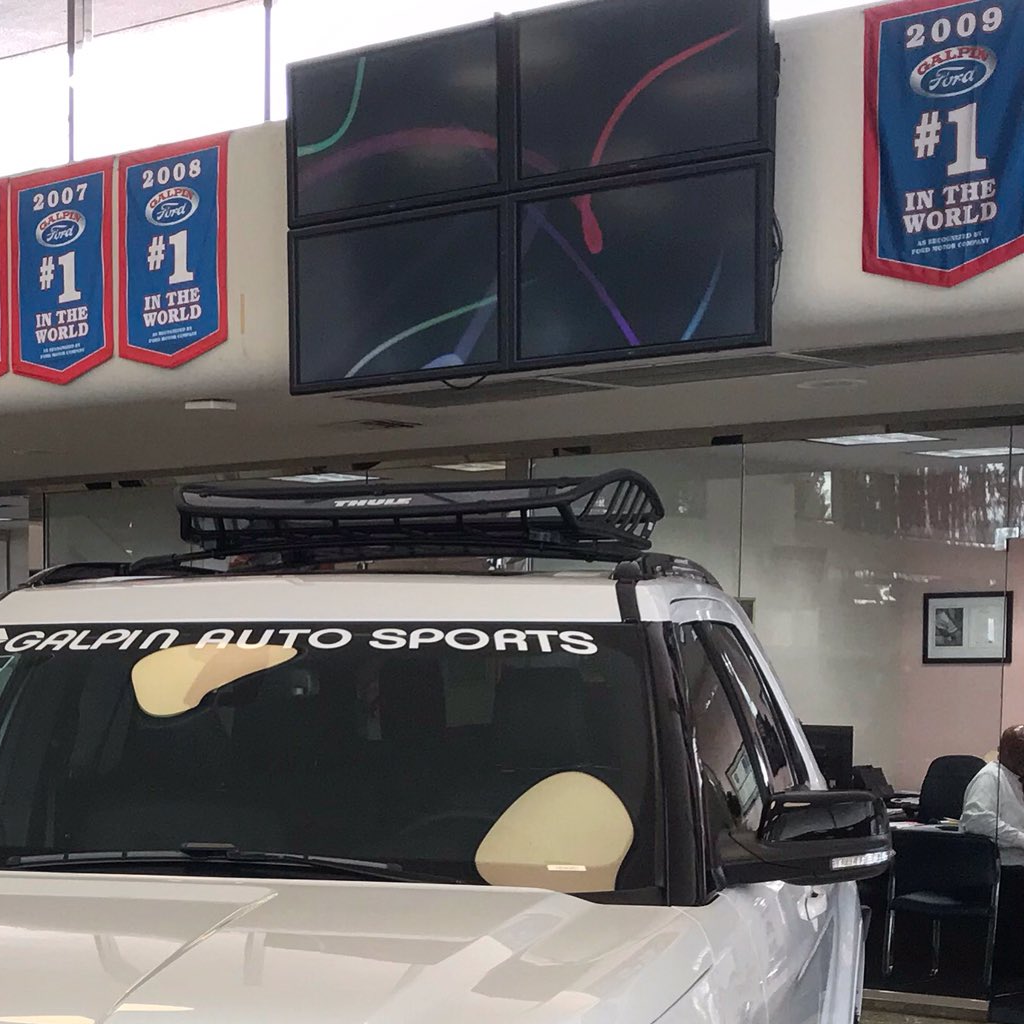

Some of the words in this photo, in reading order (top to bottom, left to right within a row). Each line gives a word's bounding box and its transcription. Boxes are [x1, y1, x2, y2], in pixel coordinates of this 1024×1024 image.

[906, 6, 1002, 48] 2009
[917, 46, 989, 76] GALPIN
[928, 66, 975, 90] Ford
[914, 102, 987, 176] #1
[142, 159, 201, 188] 2008
[33, 183, 87, 211] 2007
[149, 187, 194, 208] GALPIN
[904, 189, 934, 212] IN
[942, 179, 996, 200] THE
[39, 210, 82, 230] GALPIN
[156, 202, 186, 221] Ford
[903, 202, 998, 234] WORLD
[46, 225, 74, 243] Ford
[147, 230, 194, 284] #1
[40, 252, 81, 304] #1
[144, 294, 161, 311] IN
[166, 288, 200, 306] THE
[36, 313, 52, 328] IN
[56, 306, 88, 323] THE
[143, 306, 202, 327] WORLD
[35, 323, 89, 344] WORLD
[334, 498, 412, 507] THULE
[4, 628, 179, 652] GALPIN
[194, 628, 352, 650] AUTO
[369, 628, 598, 655] SPORTS
